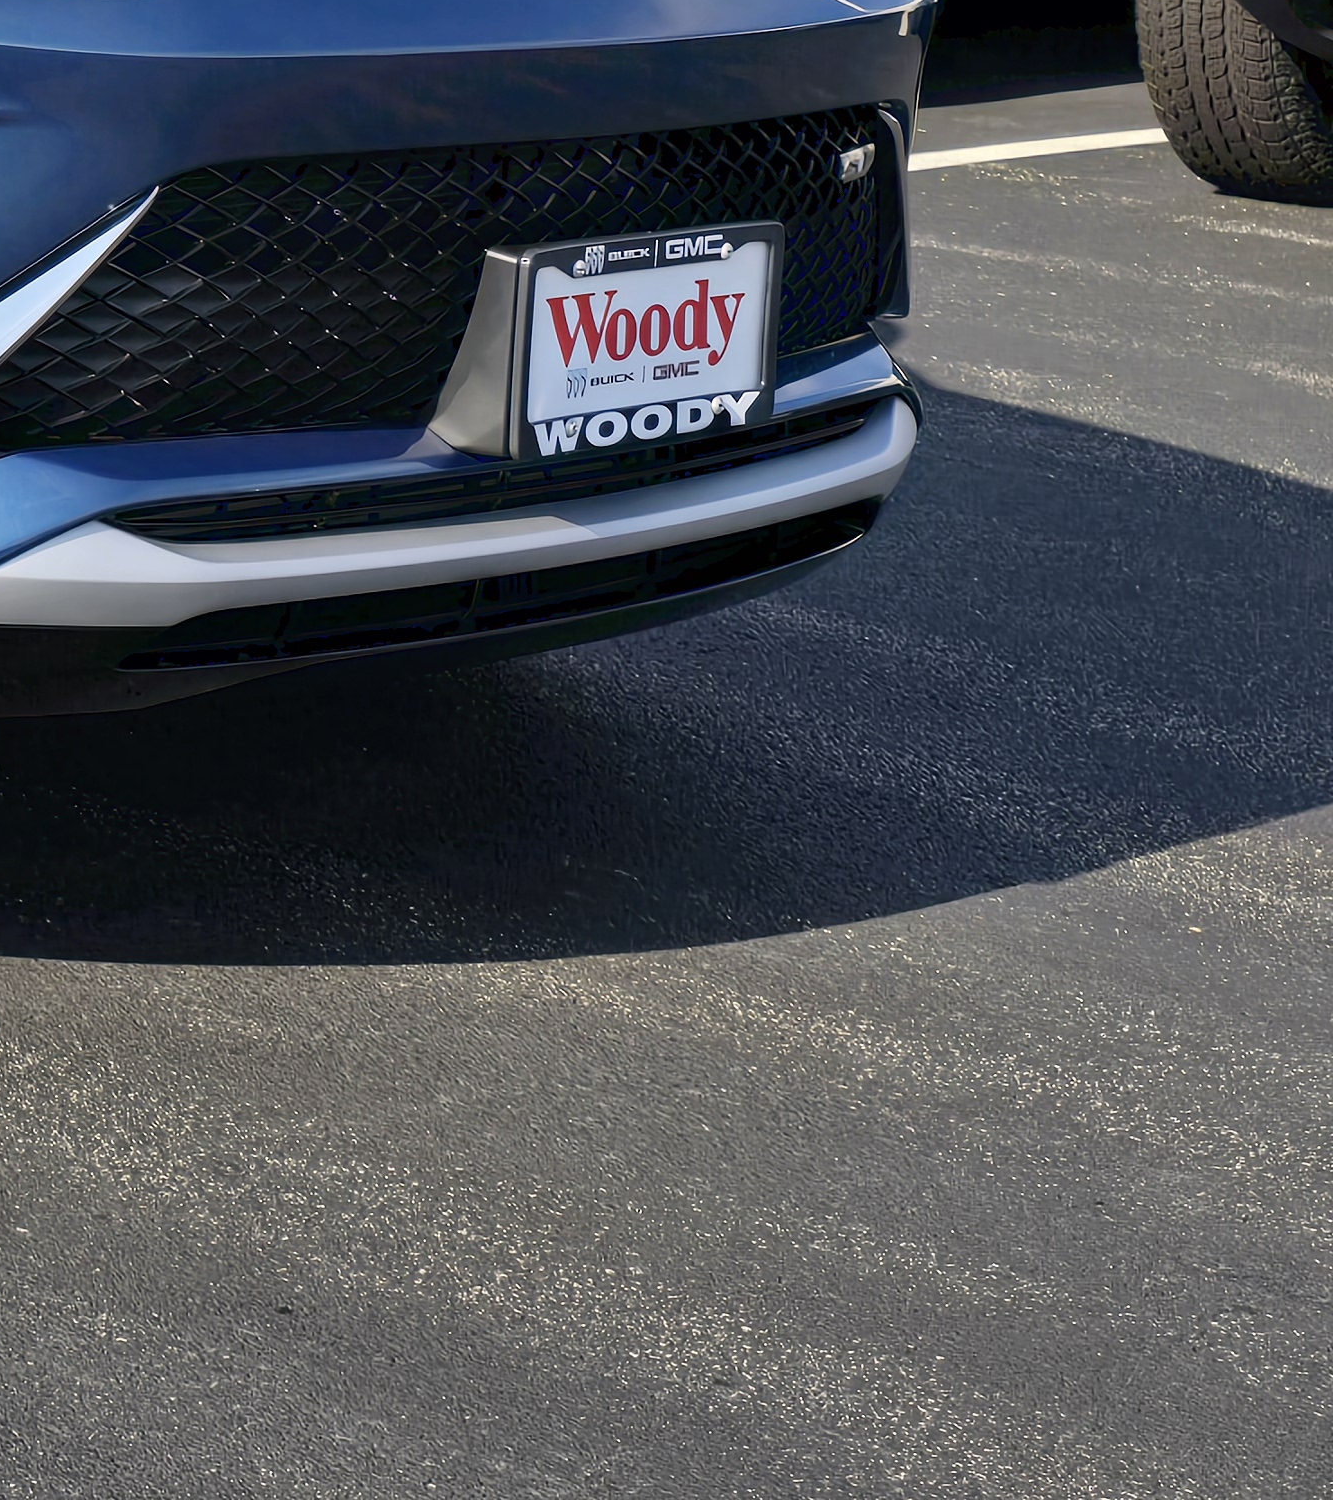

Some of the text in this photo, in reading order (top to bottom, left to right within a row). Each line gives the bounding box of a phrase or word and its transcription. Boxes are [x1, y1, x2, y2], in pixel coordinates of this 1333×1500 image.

[665, 234, 724, 260] GMC
[546, 278, 746, 369] Woody
[590, 360, 700, 387] BUICK GMC
[533, 391, 761, 457] WOODY
